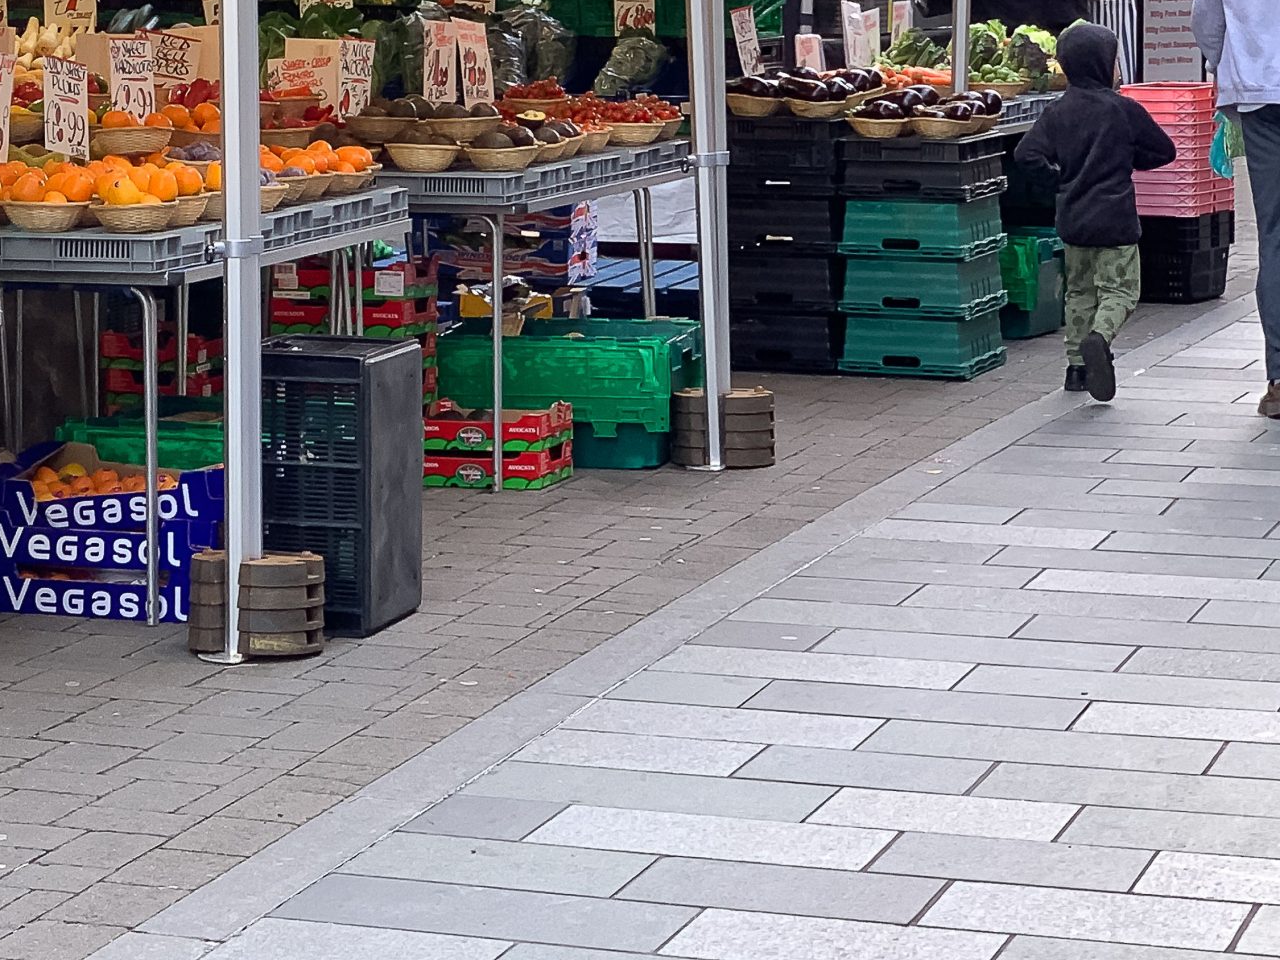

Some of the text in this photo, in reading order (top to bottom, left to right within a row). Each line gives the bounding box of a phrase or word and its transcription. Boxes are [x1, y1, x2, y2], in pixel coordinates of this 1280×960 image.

[160, 34, 191, 50] RED
[156, 46, 189, 63] BELL
[152, 57, 193, 76] PPERS
